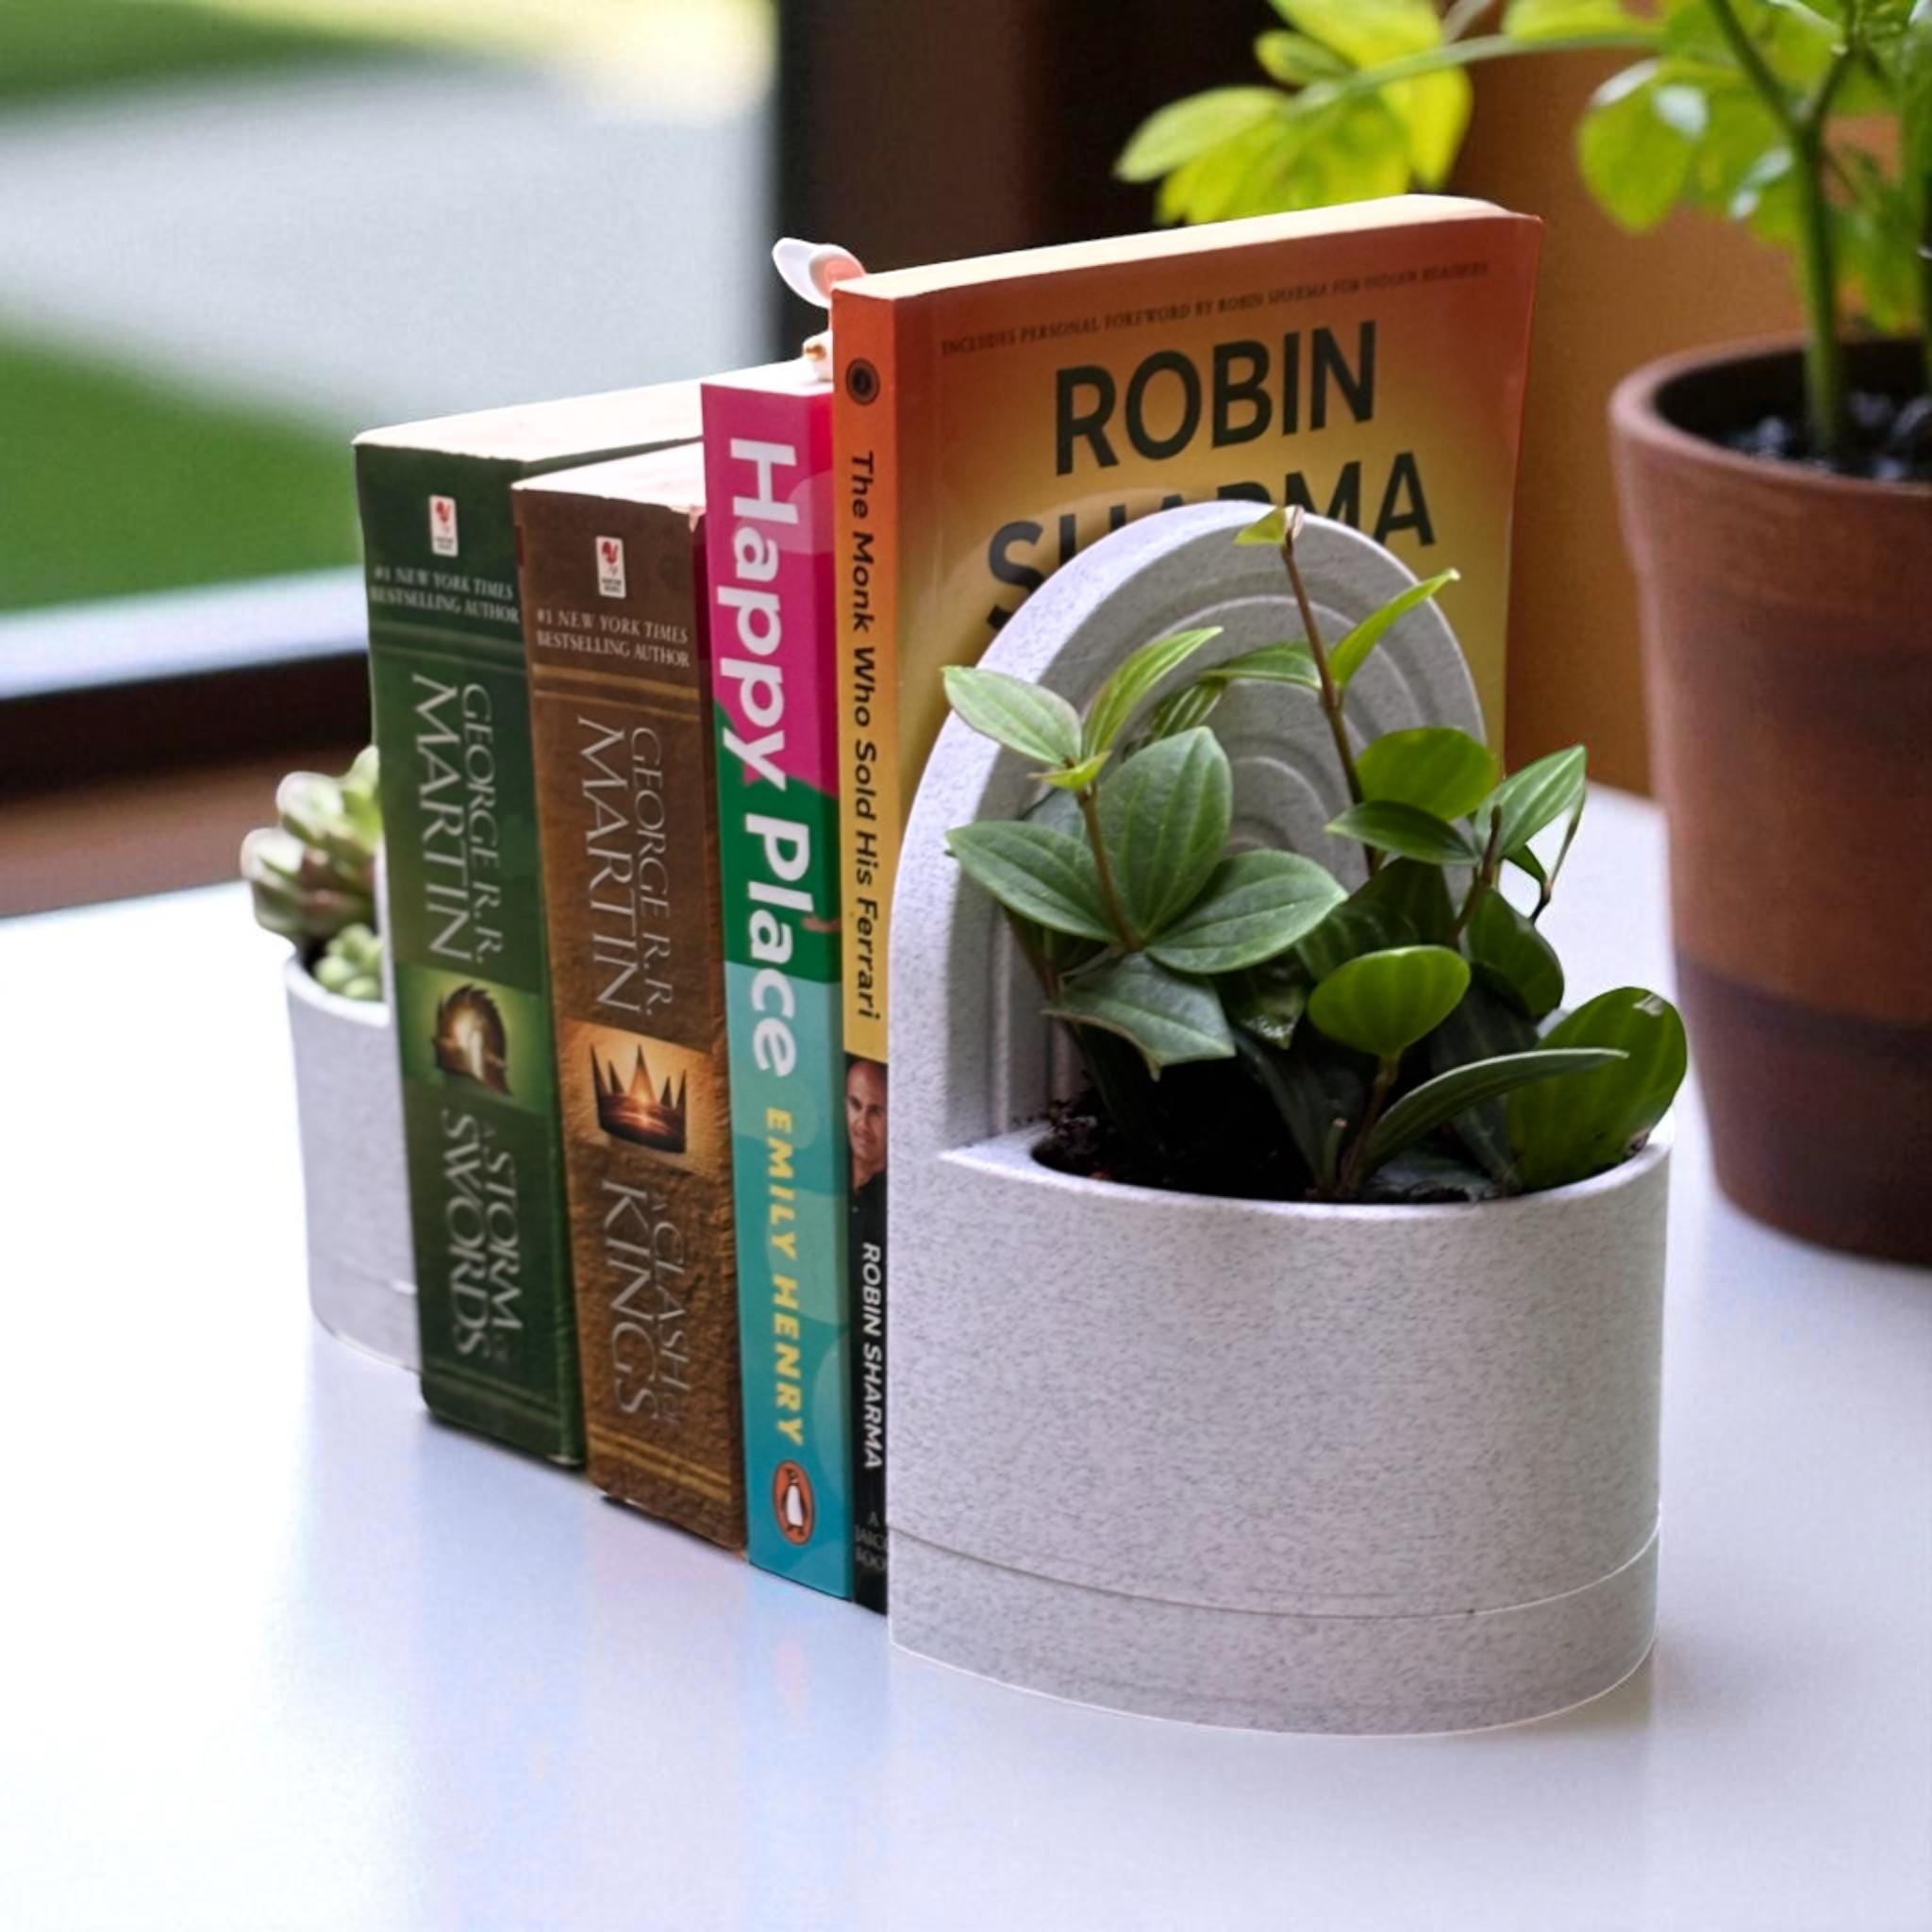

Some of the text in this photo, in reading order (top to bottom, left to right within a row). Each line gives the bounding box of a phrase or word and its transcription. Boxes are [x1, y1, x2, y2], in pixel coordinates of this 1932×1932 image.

[1020, 316, 1100, 340] PERSONAL
[1104, 304, 1191, 329] FOREWORD
[1194, 299, 1213, 317] BY
[1217, 291, 1264, 312] ROBIN
[1056, 320, 1376, 477] ROBIN
[370, 585, 520, 624] BESTSELLING AUTHOR
[395, 567, 429, 587] NEW
[434, 572, 471, 592] YORK
[474, 578, 513, 601] TIMES
[537, 629, 691, 668] BESTSELLING AUTHOR
[558, 611, 594, 630] NEW
[600, 616, 641, 637] YORK
[644, 623, 688, 644] TIMES
[412, 673, 472, 960] MARTIN
[461, 682, 499, 870] GEORGE
[630, 727, 670, 919] GEORGE
[717, 438, 814, 1077] Happy Place
[852, 450, 880, 1021] The Monk Who Sold His Ferrari
[576, 716, 642, 1013] MARTIN
[441, 1108, 491, 1358] SWORDS
[483, 1145, 523, 1330] STORM
[602, 1179, 658, 1420] KINGS
[653, 1220, 691, 1393] CLASH
[766, 1108, 803, 1446] EMILY HENRY
[862, 1242, 883, 1469] ROBIN SHARMA
